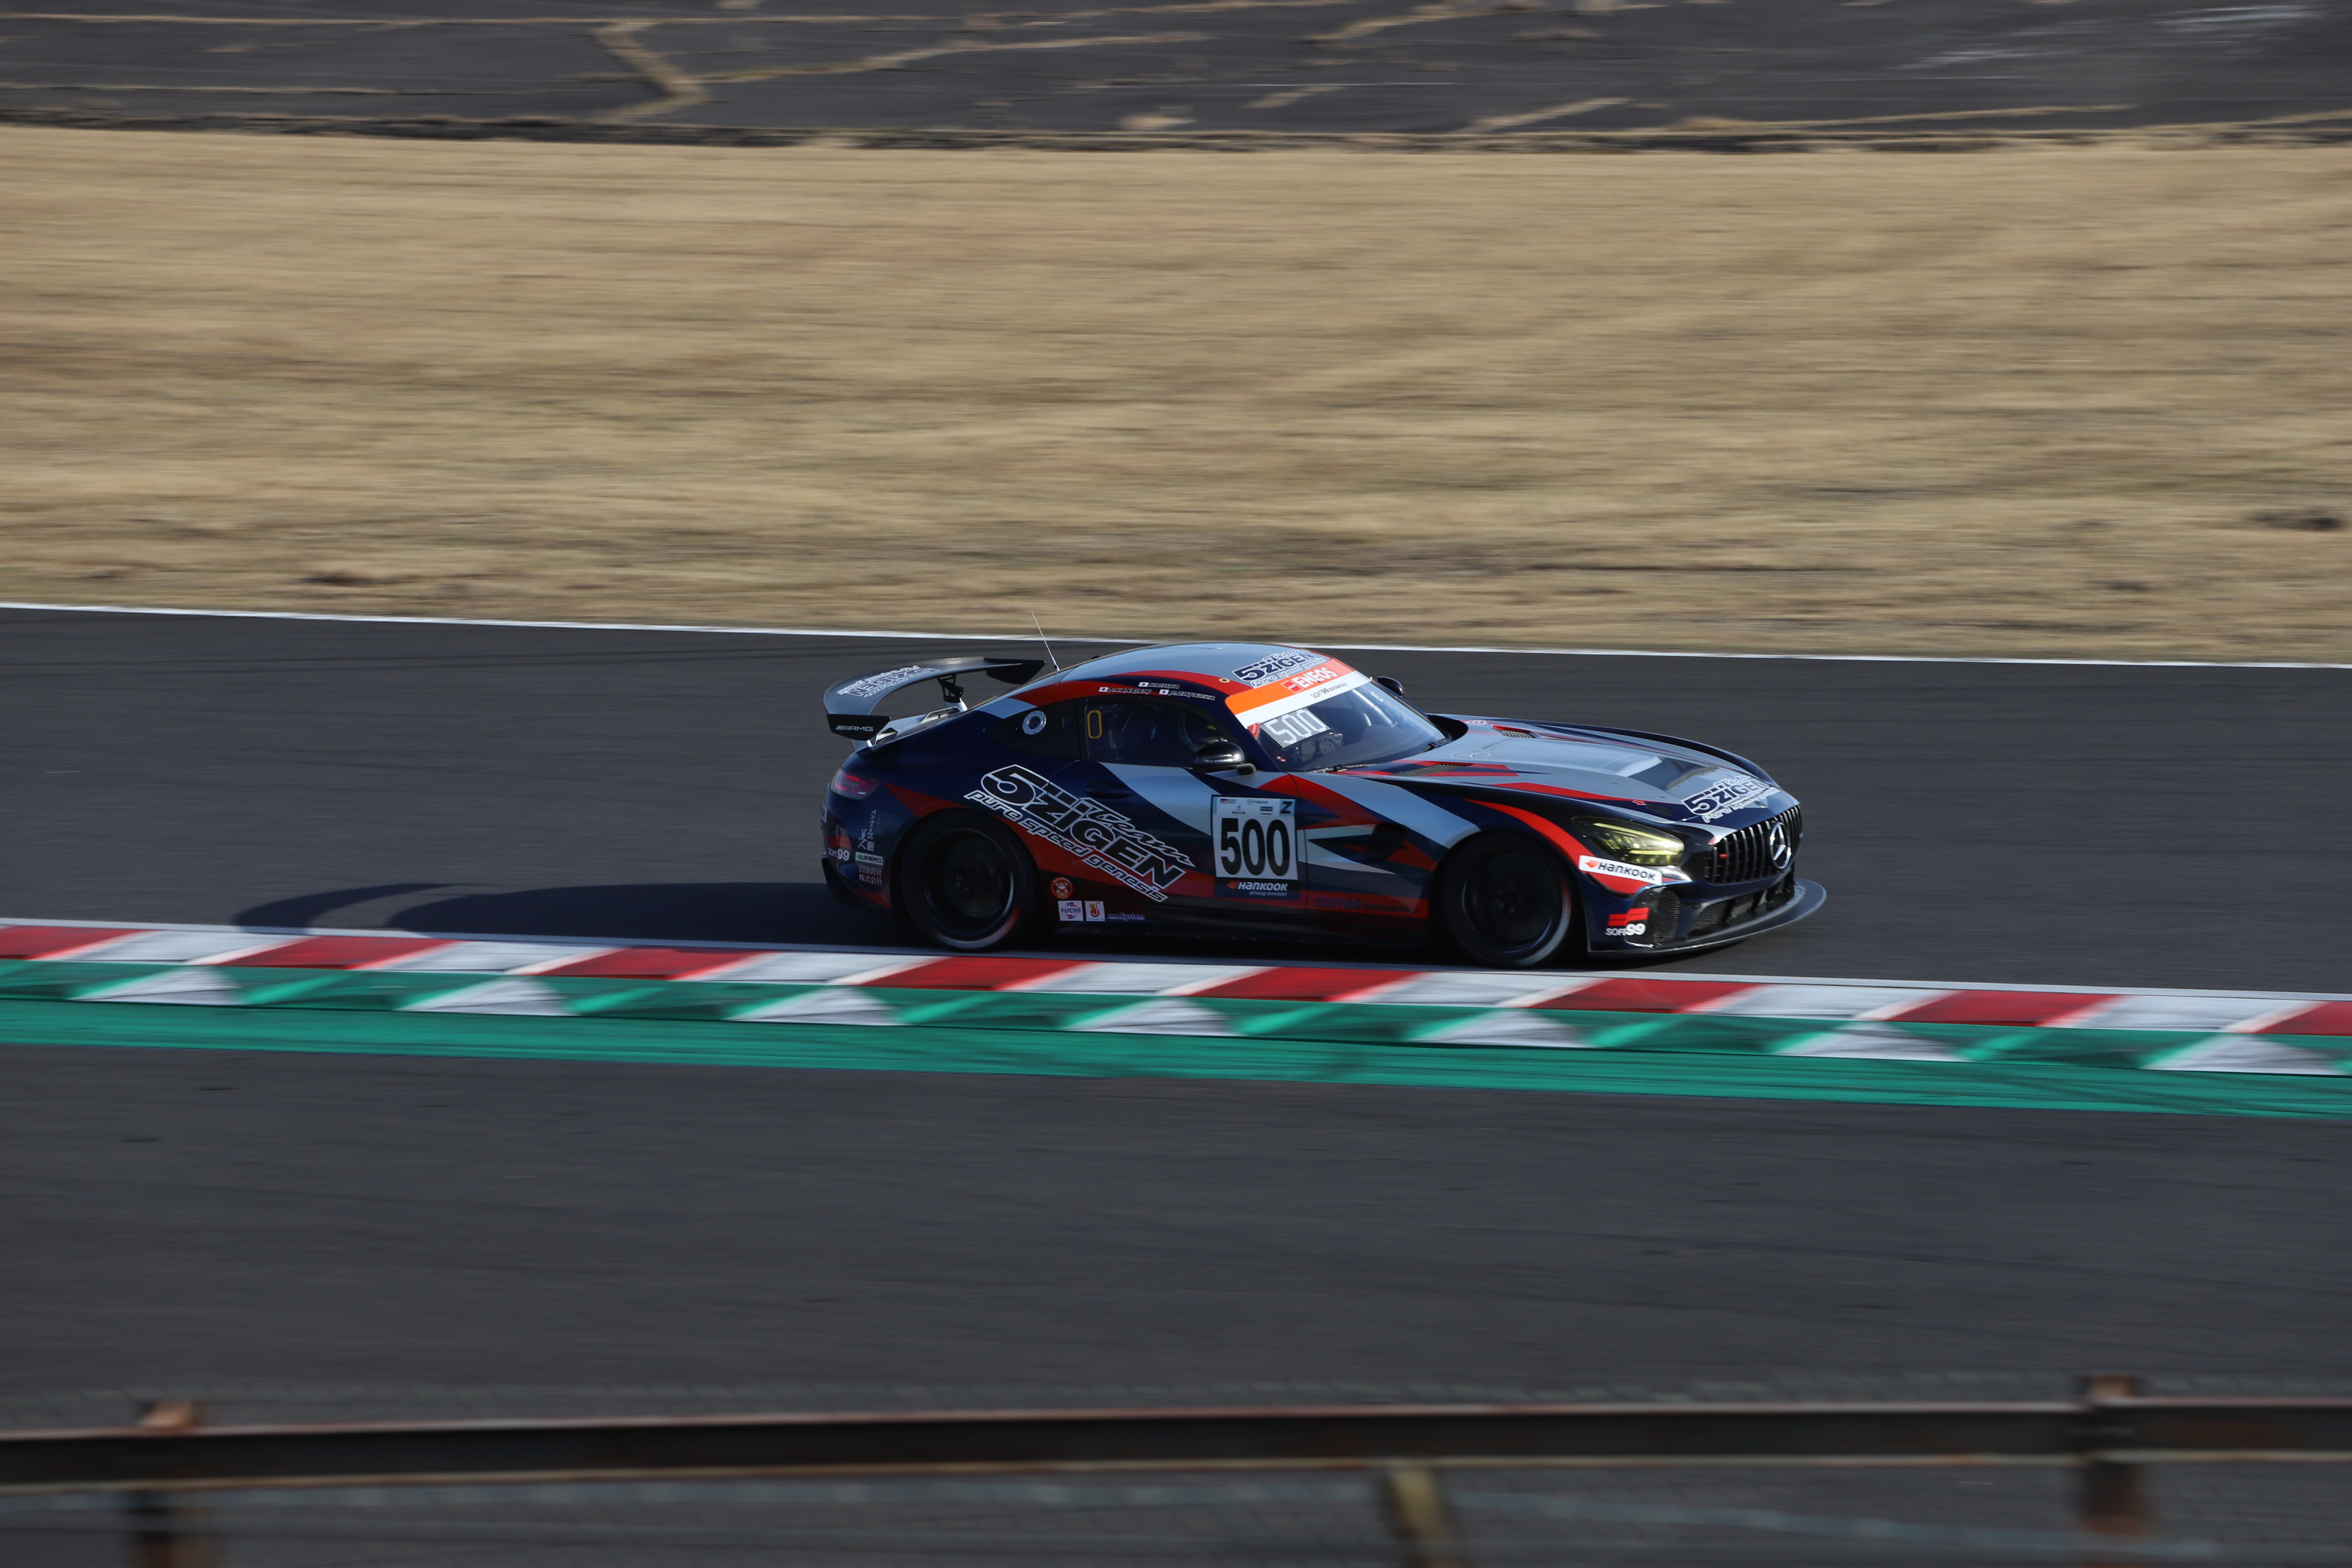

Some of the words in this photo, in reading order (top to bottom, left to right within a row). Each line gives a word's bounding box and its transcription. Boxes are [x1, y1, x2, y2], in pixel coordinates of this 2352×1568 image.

[1232, 651, 1318, 681] 5ZIGEN
[1295, 667, 1338, 689] ENEOS
[1265, 709, 1328, 745] 500
[1280, 801, 1293, 814] Z
[1681, 780, 1771, 816] 5ZIGEN
[981, 764, 1187, 890] 5ZIGEN
[1080, 797, 1196, 868] team
[828, 847, 850, 862] SOFT99
[863, 855, 882, 863] ZERO
[963, 790, 1024, 822] pure
[1018, 818, 1093, 857] speed
[1082, 853, 1169, 903] genesis
[1220, 817, 1291, 877] 500
[859, 873, 883, 886] 株式会社
[1315, 897, 1362, 910] SOFT99
[1605, 923, 1646, 936] SOFT99
